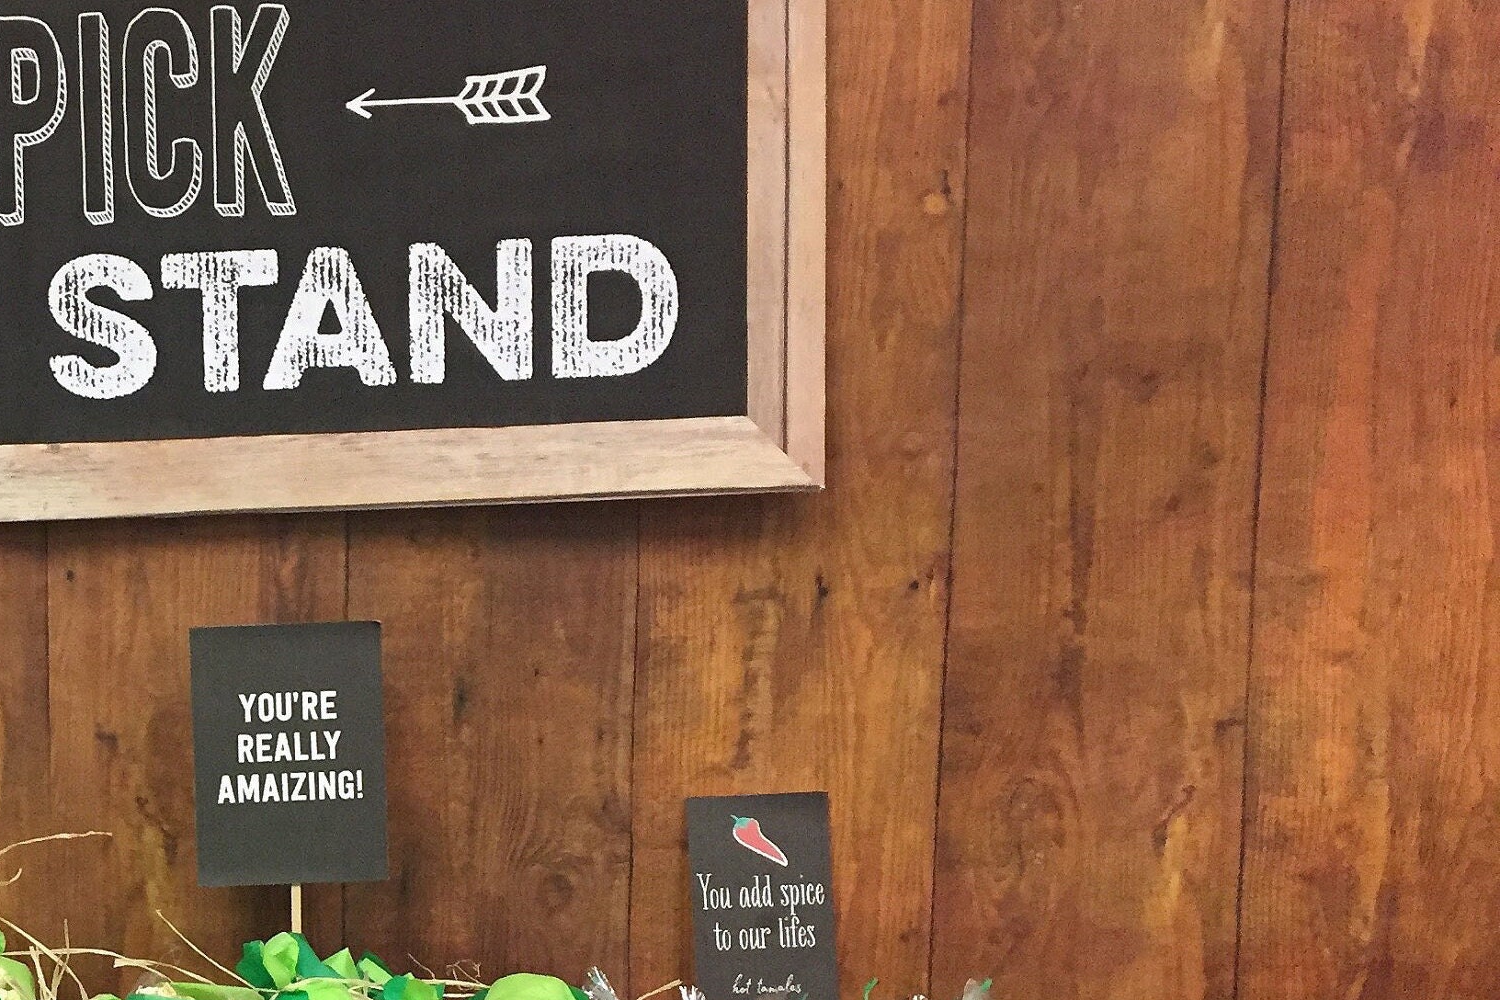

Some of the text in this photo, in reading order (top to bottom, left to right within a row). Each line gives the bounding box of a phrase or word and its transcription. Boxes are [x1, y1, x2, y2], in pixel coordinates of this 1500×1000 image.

[47, 233, 679, 399] STAND
[238, 690, 337, 722] YOU'RE
[237, 730, 341, 763] REALLY
[217, 769, 363, 804] AMAIZING!
[696, 872, 824, 915] You add spice
[712, 915, 816, 950] to our lifes
[732, 973, 751, 993] hot
